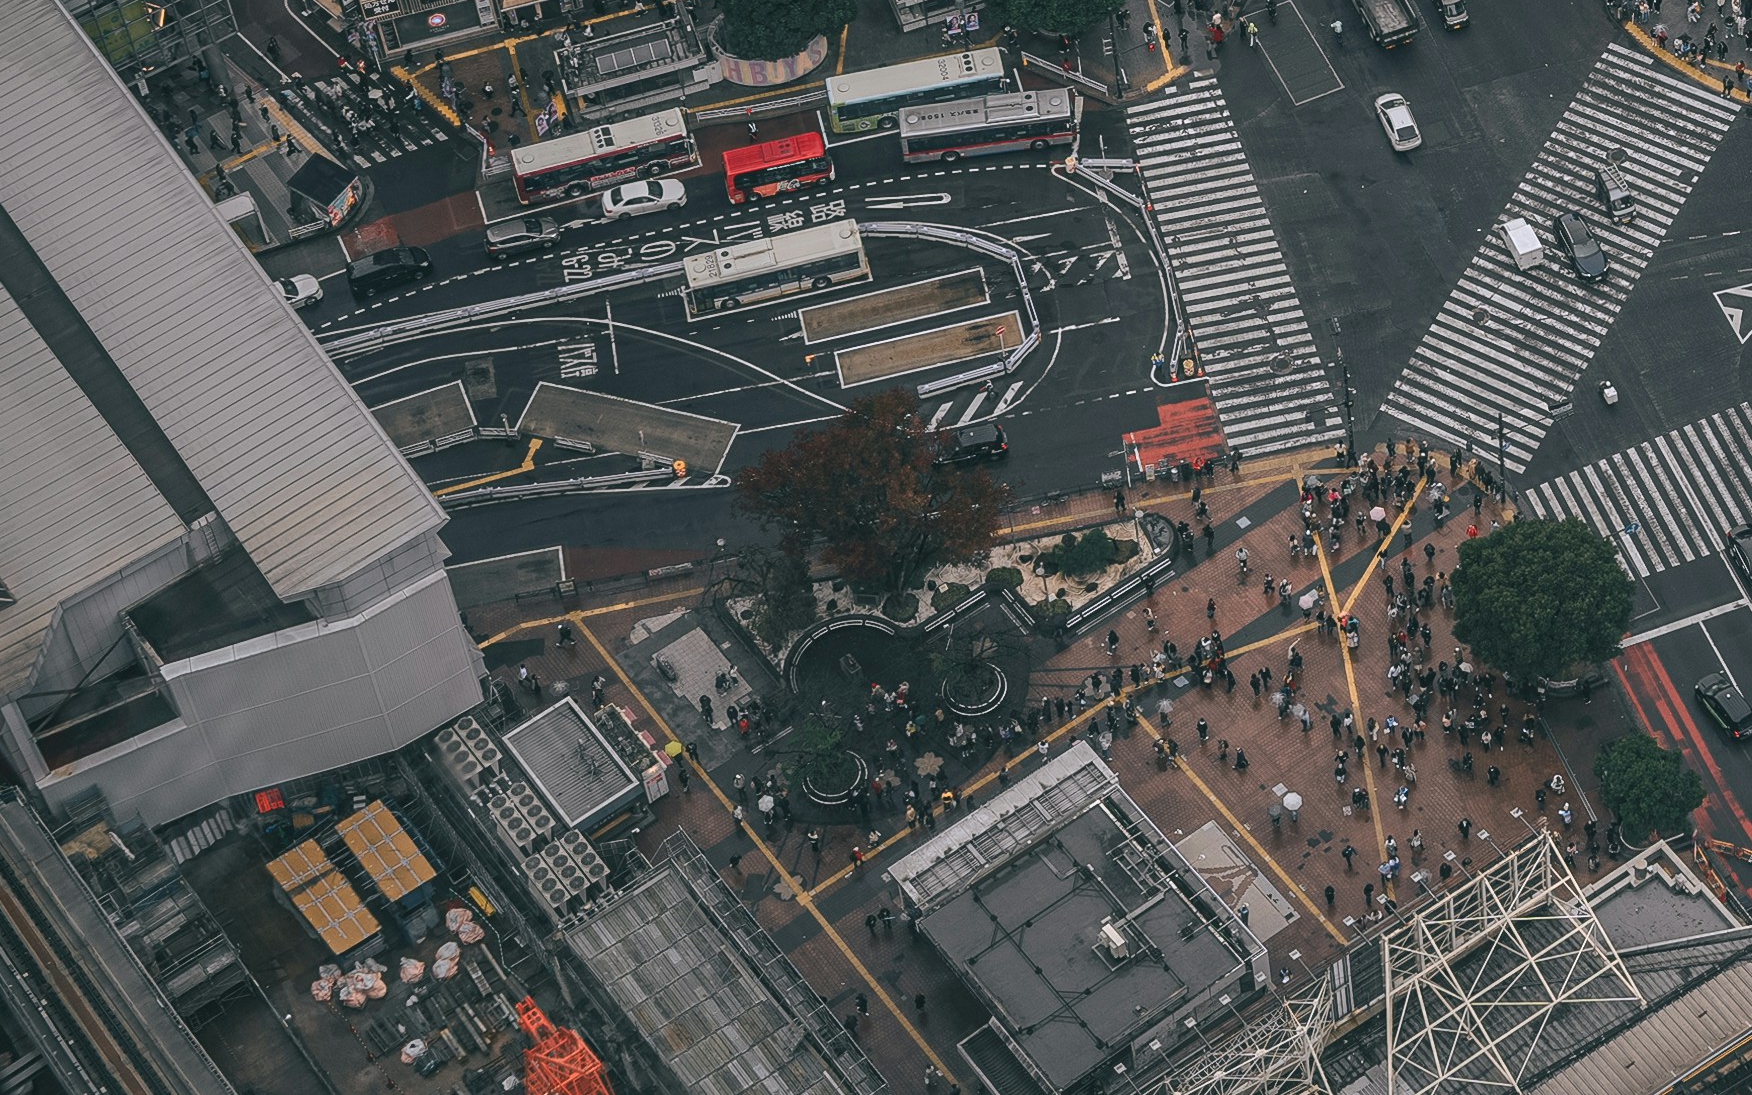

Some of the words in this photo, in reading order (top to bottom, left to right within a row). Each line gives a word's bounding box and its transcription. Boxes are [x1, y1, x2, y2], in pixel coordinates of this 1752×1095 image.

[373, 4, 389, 15] 受付
[937, 58, 950, 81] 32004
[705, 255, 718, 279] 21829
